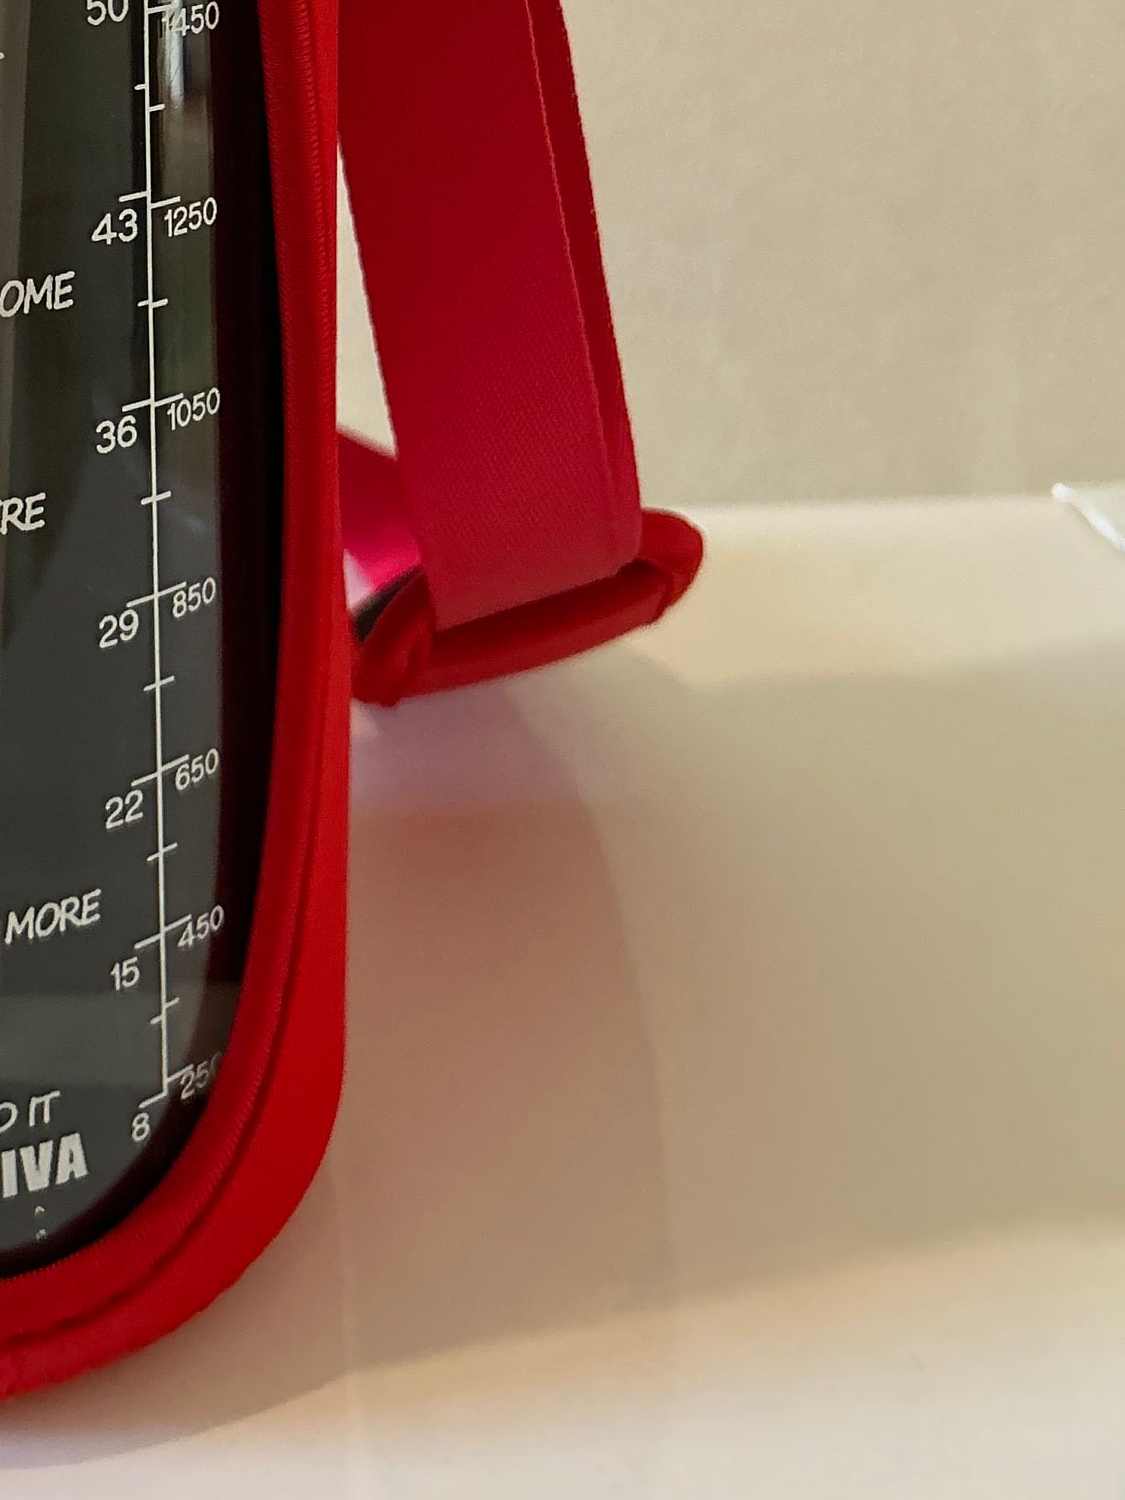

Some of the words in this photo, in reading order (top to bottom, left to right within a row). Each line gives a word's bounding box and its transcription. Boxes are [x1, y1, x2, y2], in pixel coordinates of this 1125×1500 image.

[161, 1, 220, 37] 1450
[91, 208, 138, 245] 43
[163, 197, 218, 237] 1250
[167, 387, 220, 430] 1050
[95, 415, 138, 454] 36
[172, 577, 216, 618] 850
[98, 609, 139, 649] 29
[175, 748, 219, 791] 650
[105, 789, 144, 830] 22
[4, 889, 102, 946] MORE
[178, 905, 224, 948] 450
[110, 956, 140, 991] 15
[28, 1090, 60, 1127] IT
[131, 1112, 150, 1142] 8
